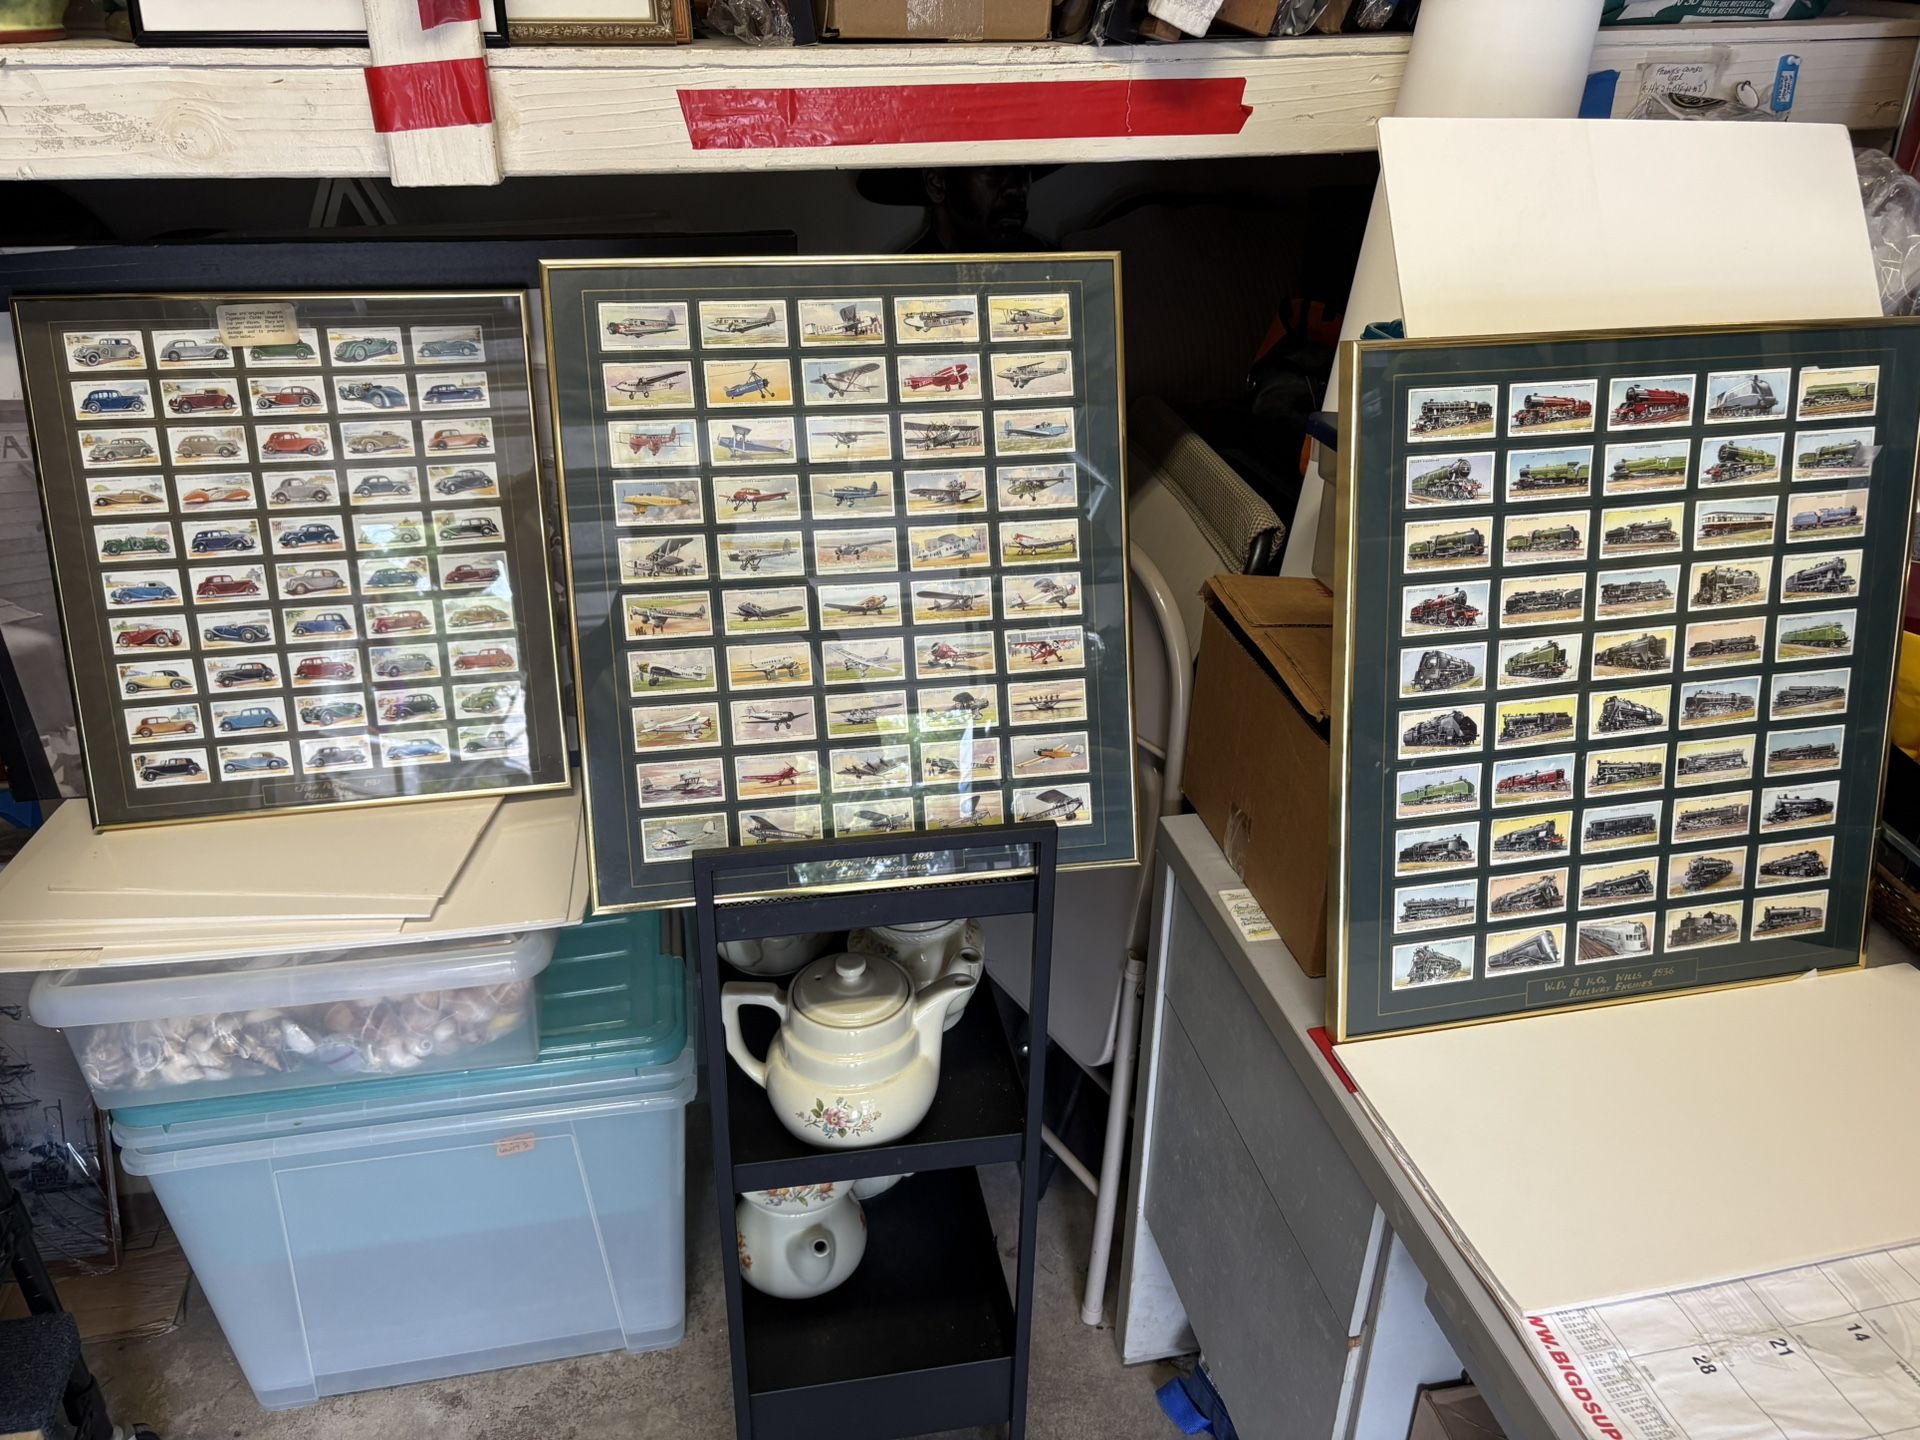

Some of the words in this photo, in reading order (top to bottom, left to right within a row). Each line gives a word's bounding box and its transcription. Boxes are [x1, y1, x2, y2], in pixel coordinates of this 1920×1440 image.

[1846, 1322, 1872, 1343] 14
[1769, 1337, 1796, 1358] 21
[1692, 1354, 1718, 1376] 28
